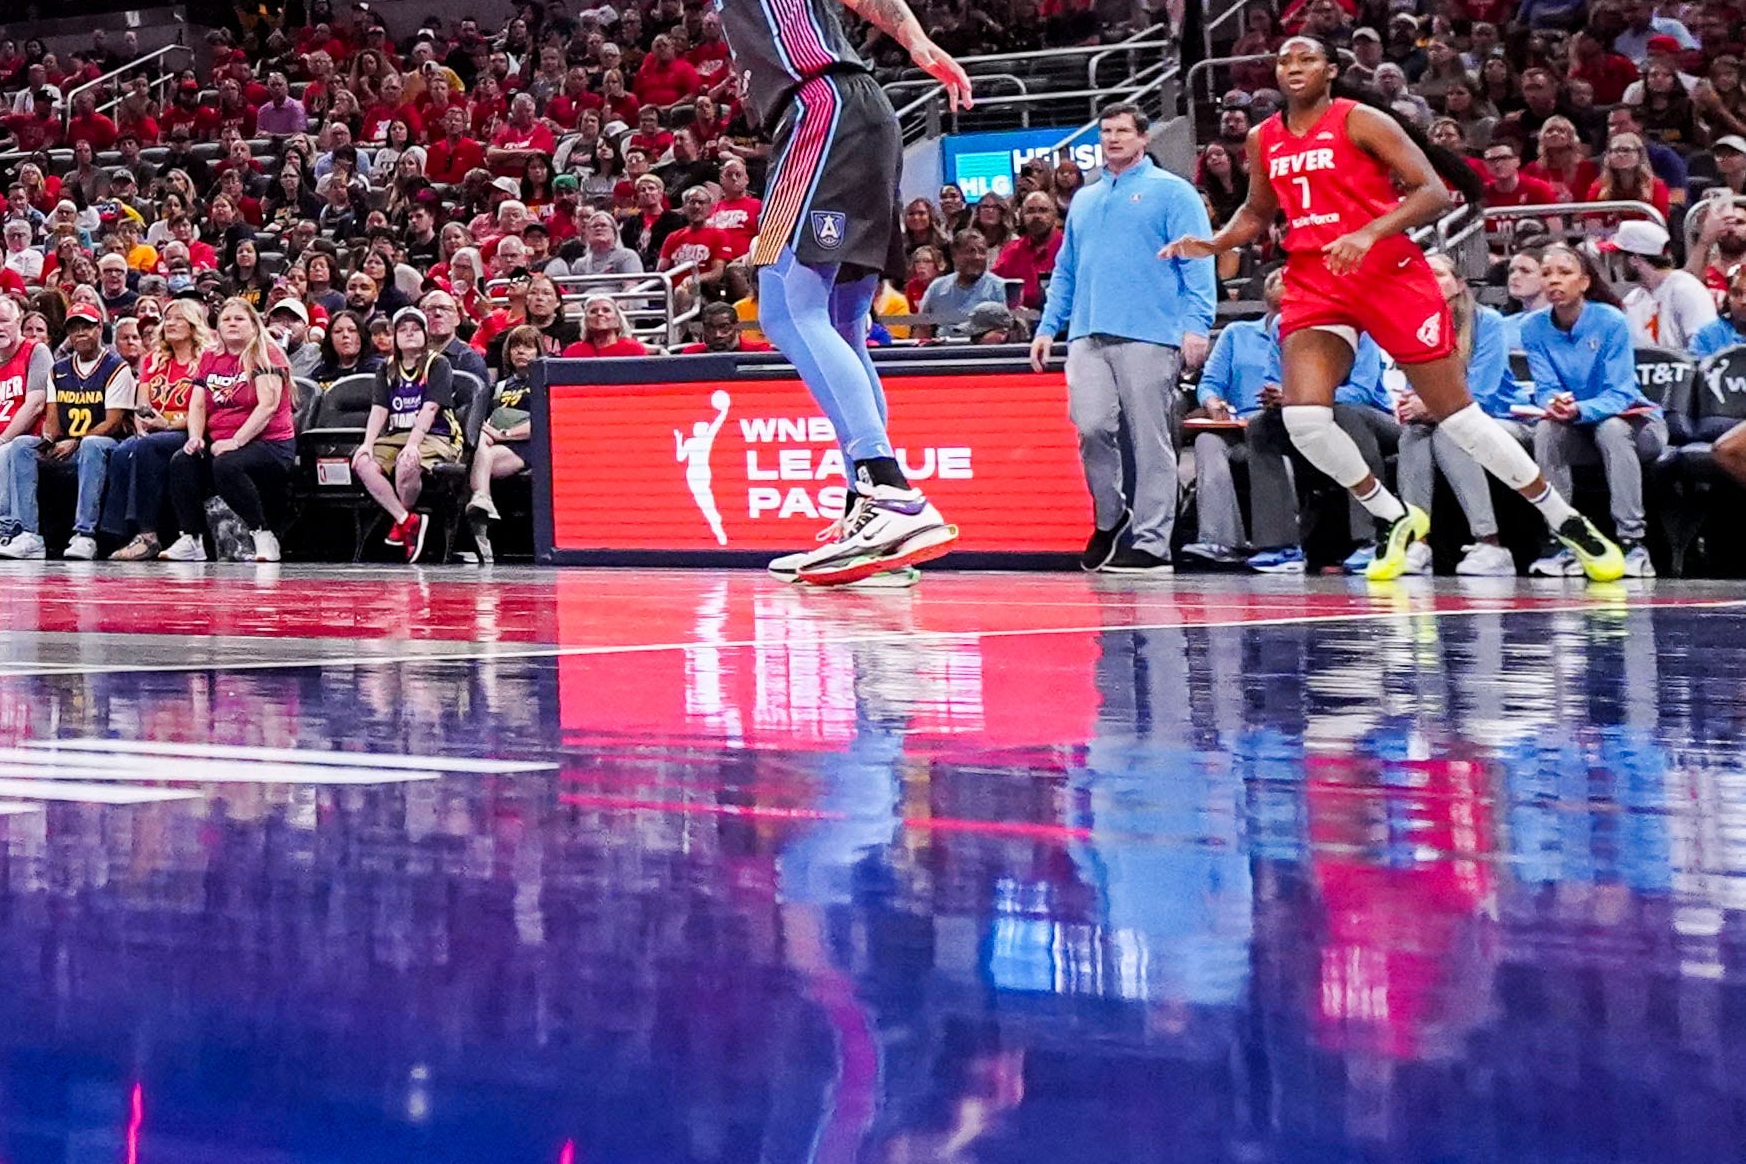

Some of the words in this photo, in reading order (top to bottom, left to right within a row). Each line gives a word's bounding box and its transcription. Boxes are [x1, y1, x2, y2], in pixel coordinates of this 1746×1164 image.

[1269, 148, 1335, 179] FEVER
[1292, 176, 1310, 209] 7
[1634, 362, 1692, 386] T&T
[57, 388, 103, 405] INDIANA
[68, 408, 91, 436] 22
[740, 417, 836, 442] WNB
[745, 447, 974, 481] LEAUE
[747, 486, 848, 519] PAS
